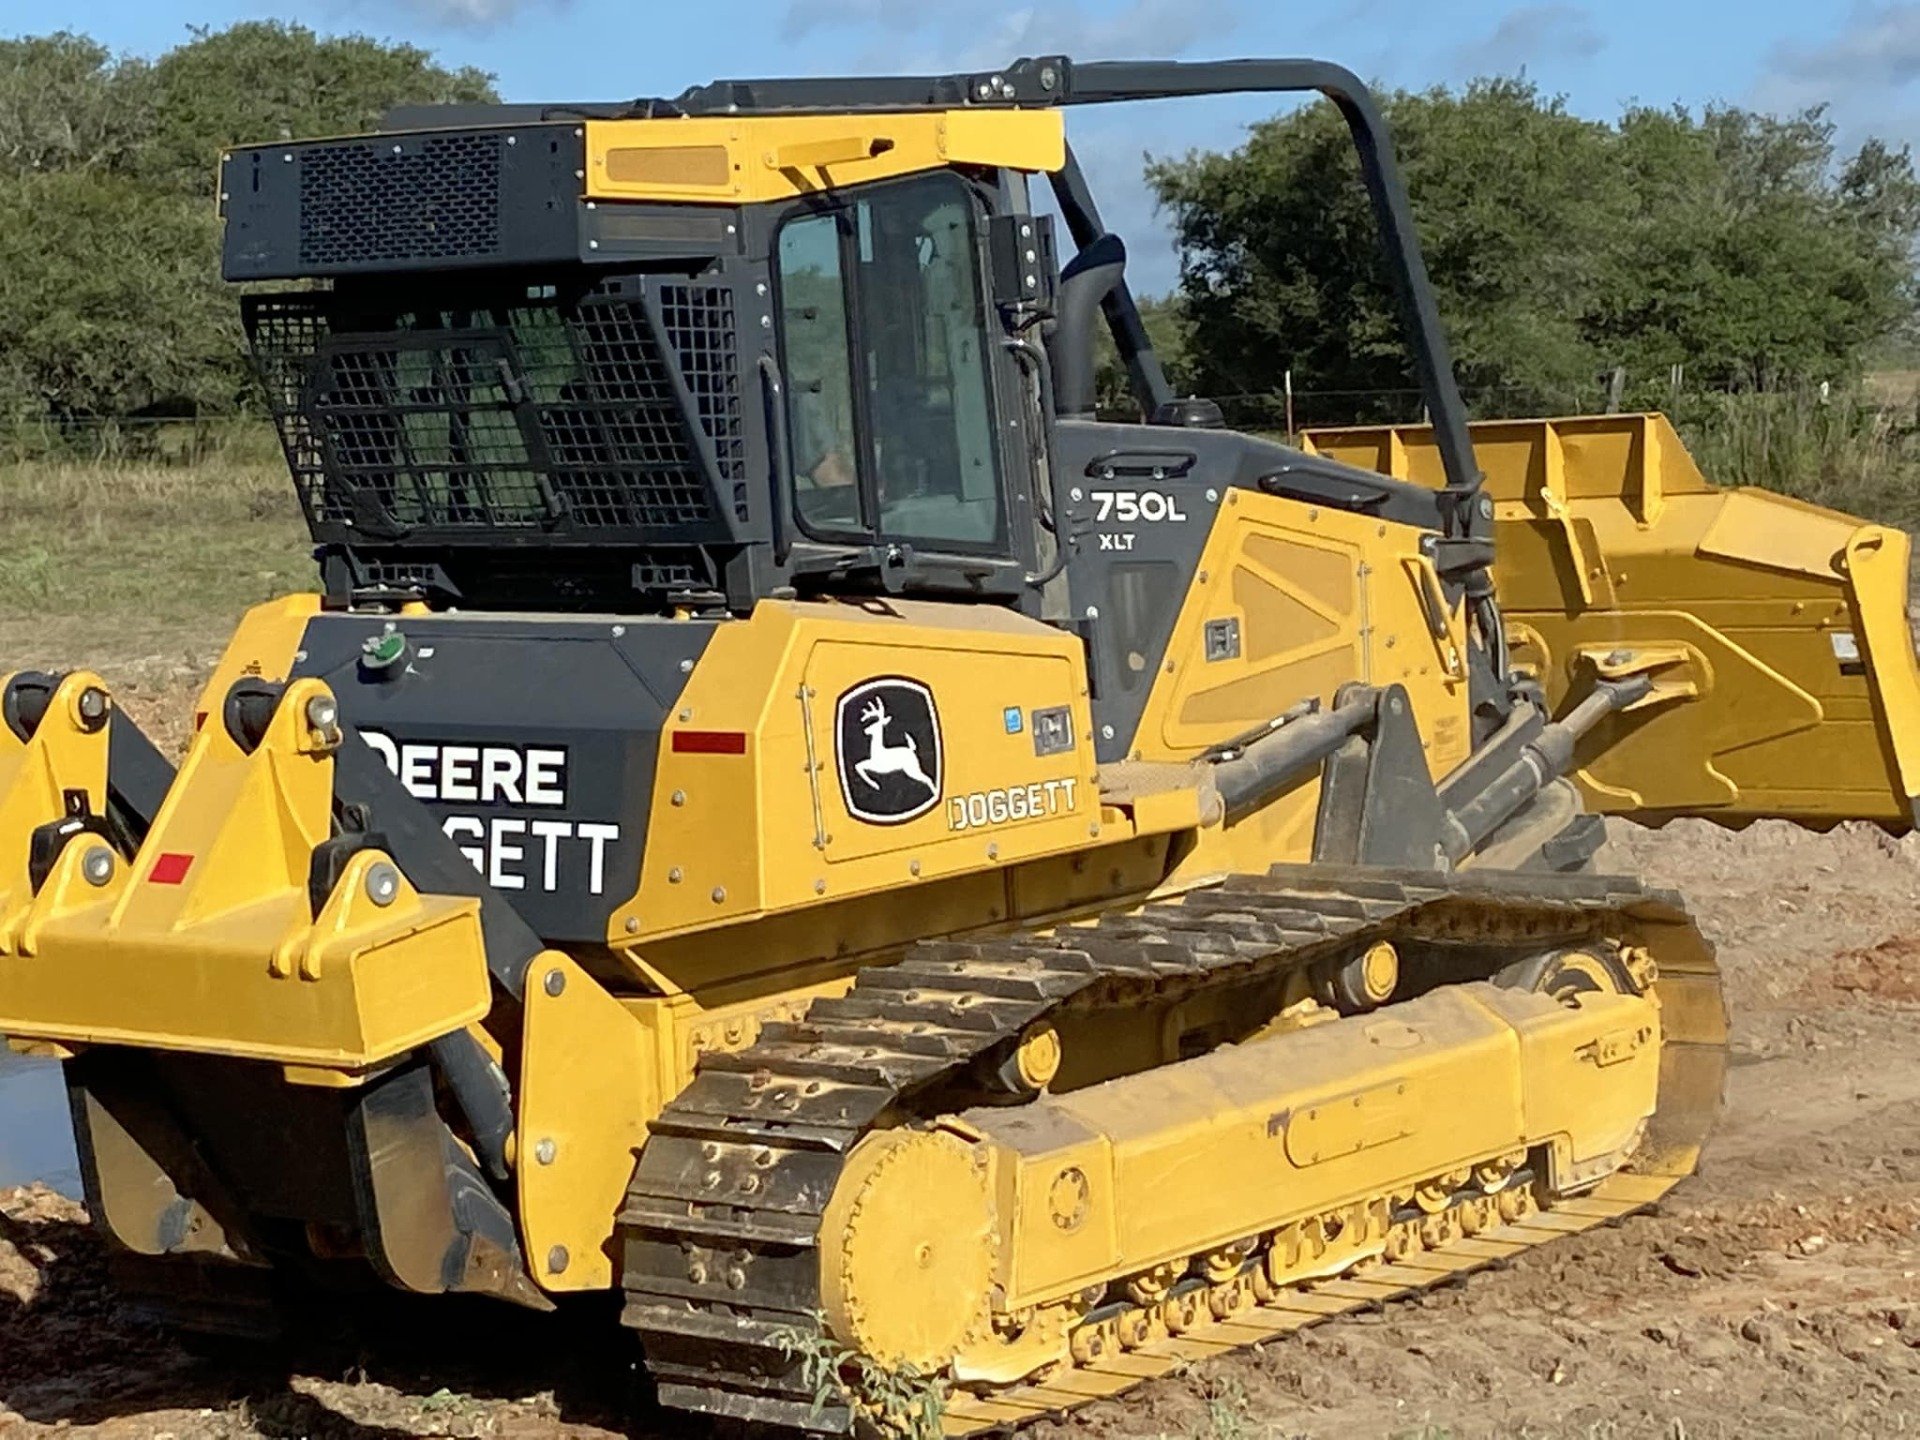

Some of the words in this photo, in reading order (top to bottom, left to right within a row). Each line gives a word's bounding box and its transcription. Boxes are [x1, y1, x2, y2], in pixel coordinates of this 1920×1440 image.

[1091, 491, 1186, 521] 750L
[1098, 533, 1136, 550] XLT
[946, 777, 1077, 831] DOGGETT
